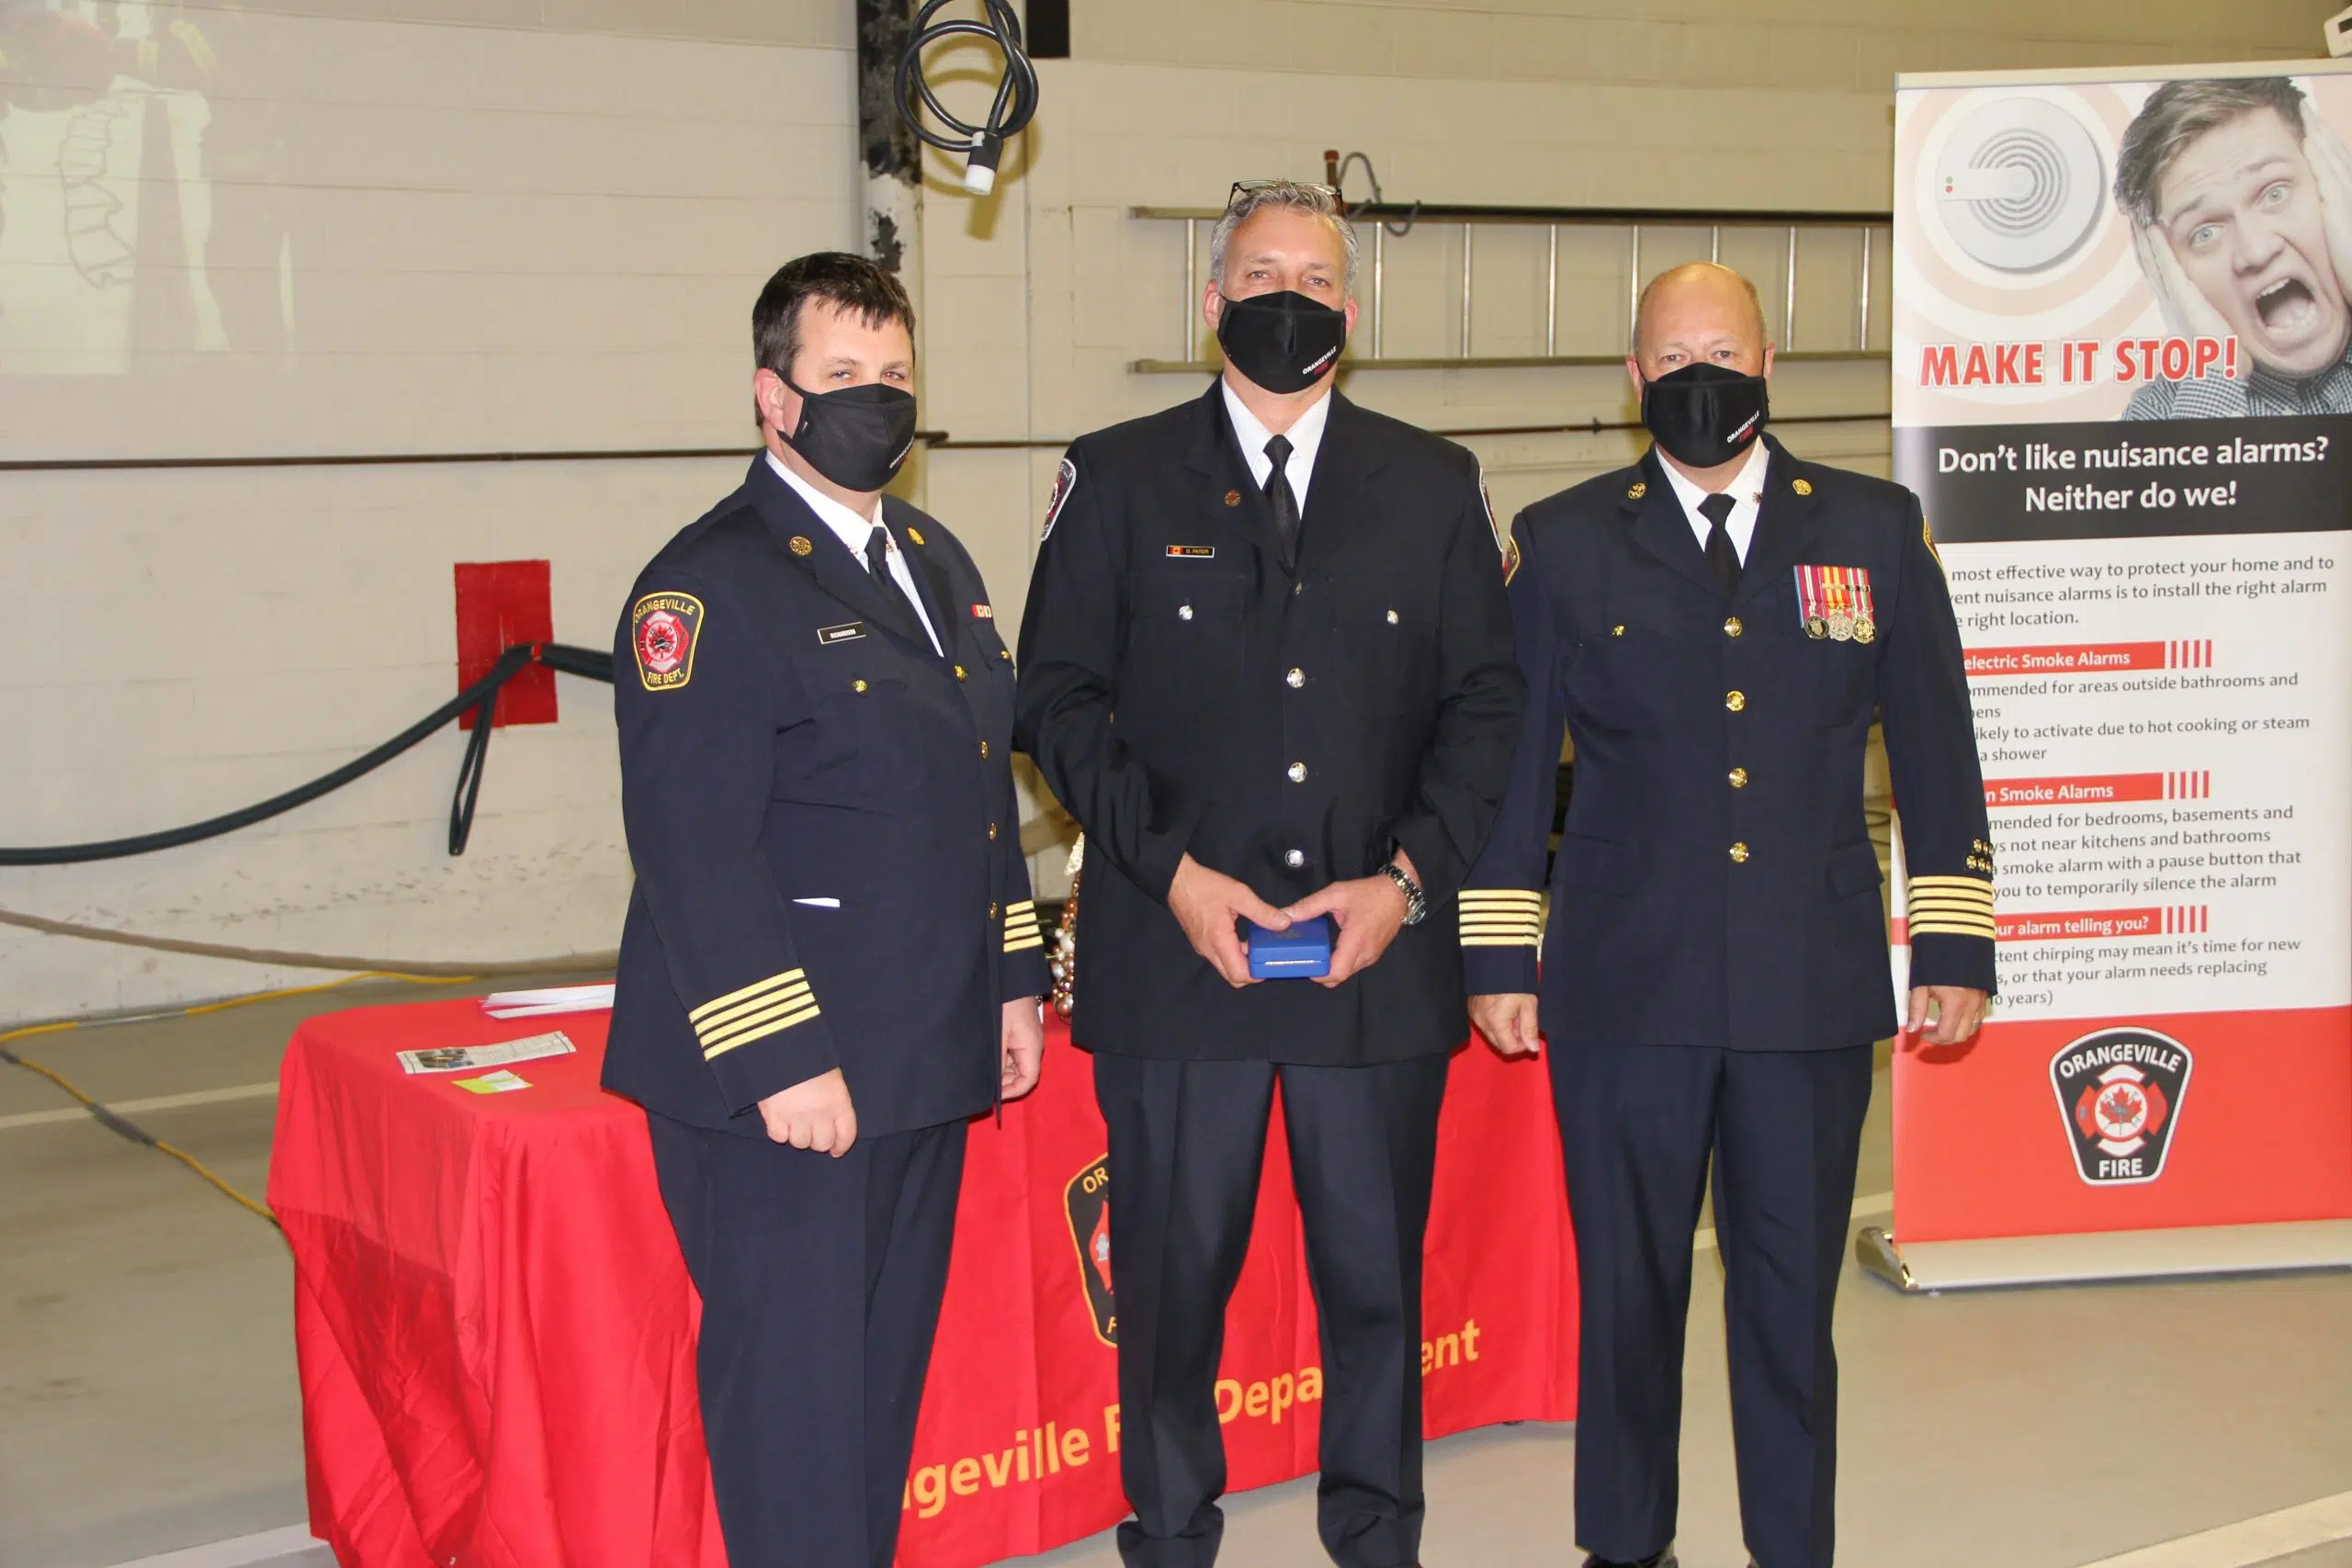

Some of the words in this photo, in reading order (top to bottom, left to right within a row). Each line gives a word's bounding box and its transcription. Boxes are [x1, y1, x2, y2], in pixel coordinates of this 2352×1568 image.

[1921, 344, 2042, 386] MAKE
[2063, 343, 2099, 383] IT
[2116, 337, 2235, 381] STOP!
[2026, 444, 2075, 469] like
[2085, 442, 2208, 468] nuisance
[2217, 436, 2328, 463] alarms?
[2027, 484, 2132, 511] Neither
[2141, 482, 2176, 507] do
[2184, 481, 2236, 505] we!
[1952, 569, 1991, 581] most
[1996, 565, 2064, 579] effective
[2071, 568, 2102, 580] way
[2108, 565, 2122, 575] to
[2128, 562, 2185, 579] protect
[2190, 563, 2226, 576] your
[2233, 558, 2278, 571] home
[2284, 557, 2312, 570] and
[2319, 558, 2334, 569] to
[1985, 590, 2053, 603] nuisance
[2059, 587, 2111, 601] alarms
[2117, 586, 2127, 598] is
[2133, 586, 2148, 598] to
[2154, 582, 2199, 597] install
[2205, 582, 2231, 595] the
[2236, 581, 2275, 598] right
[2281, 580, 2326, 593] alarm
[1968, 613, 2005, 630] right
[2011, 611, 2078, 625] location.
[1963, 654, 2018, 670] electric
[2022, 653, 2074, 667] Smoke
[2078, 652, 2130, 665] Alarms
[648, 671, 662, 684] FIRE
[2052, 681, 2073, 693] for
[2079, 682, 2118, 693] areas
[2122, 677, 2176, 691] outside
[2181, 675, 2264, 688] bathrooms
[2270, 672, 2297, 685] and
[1975, 726, 2009, 742] ikely
[2015, 728, 2029, 738] to
[2034, 725, 2093, 737] activate
[2098, 723, 2124, 735] due
[2130, 724, 2143, 733] to
[2148, 720, 2172, 732] hot
[2177, 718, 2236, 734] cooking
[2242, 720, 2257, 729] or
[2264, 718, 2309, 728] steam
[1993, 748, 2047, 761] shower
[2001, 786, 2053, 801] Smoke
[2058, 784, 2113, 798] Alarms
[1988, 814, 2052, 829] mended
[2058, 814, 2080, 827] for
[2086, 811, 2168, 828] bedrooms,
[2173, 808, 2258, 821] basements
[2264, 806, 2292, 818] and
[2011, 840, 2036, 851] not
[2042, 840, 2076, 850] near
[2082, 834, 2145, 849] kitchens
[2151, 831, 2177, 845] and
[2184, 830, 2270, 843] bathrooms
[2003, 860, 2052, 874] smoke
[2059, 860, 2102, 872] alarm
[2108, 856, 2141, 869] with
[2147, 859, 2154, 868] a
[2159, 858, 2204, 871] pause
[2210, 852, 2262, 865] button
[2269, 851, 2301, 863] that
[2027, 886, 2041, 896] to
[2047, 879, 2138, 897] temporarily
[2144, 877, 2195, 890] silence
[2201, 875, 2225, 888] the
[2231, 874, 2276, 886] alarm
[2018, 920, 2060, 934] alarm
[2065, 919, 2111, 935] telling
[2116, 917, 2148, 933] you?
[2033, 948, 2093, 963] chirping
[2099, 948, 2128, 959] may
[2133, 946, 2172, 955] mean
[2204, 941, 2236, 953] time
[2242, 939, 2262, 951] for
[2268, 942, 2300, 950] new
[2012, 974, 2027, 982] or
[2033, 970, 2062, 981] that
[2068, 971, 2099, 983] your
[2106, 966, 2145, 978] alarm
[2151, 963, 2192, 976] needs
[2198, 961, 2267, 977] replacing
[2008, 991, 2052, 1007] years)
[2060, 1043, 2182, 1078] ORANGEVILLE
[2099, 1158, 2143, 1178] FIRE
[902, 1421, 1091, 1519] geville
